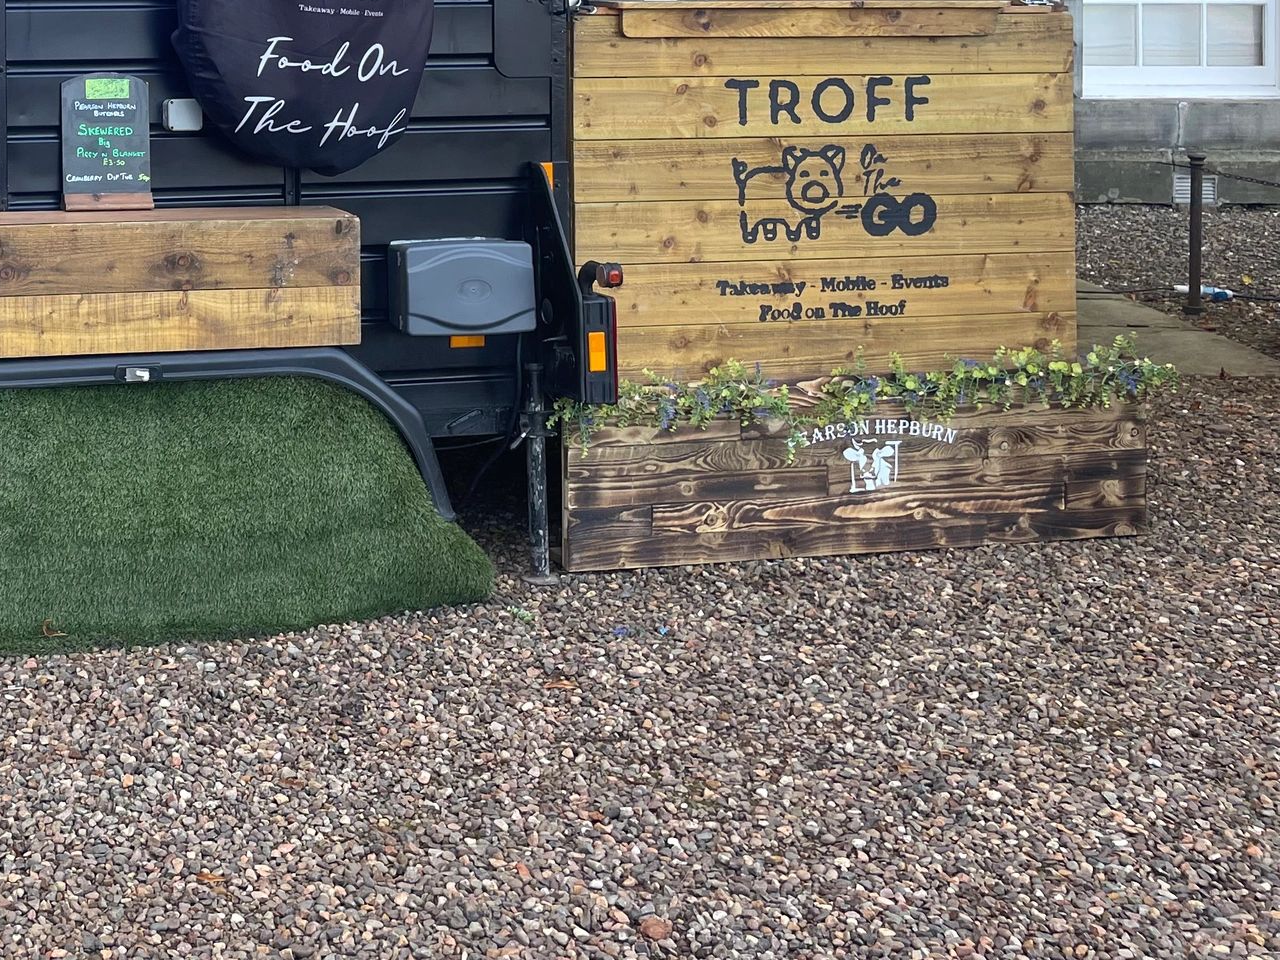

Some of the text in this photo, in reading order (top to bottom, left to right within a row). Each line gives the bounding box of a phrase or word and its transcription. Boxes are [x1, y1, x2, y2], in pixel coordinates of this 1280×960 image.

[298, 4, 384, 17] Takeaway Mobile Events
[257, 36, 409, 82] Food On
[724, 75, 931, 126] TROFF
[78, 124, 133, 136] SKEWERED
[234, 96, 407, 150] The Hoof
[860, 144, 888, 169] On
[862, 169, 902, 196] The
[861, 192, 937, 237] GO
[716, 280, 807, 297] Takeaway
[820, 276, 876, 292] Mobile
[891, 274, 949, 289] Events
[759, 300, 907, 322] Food on The Hoof
[784, 419, 958, 448] EARSON HEPBURN
